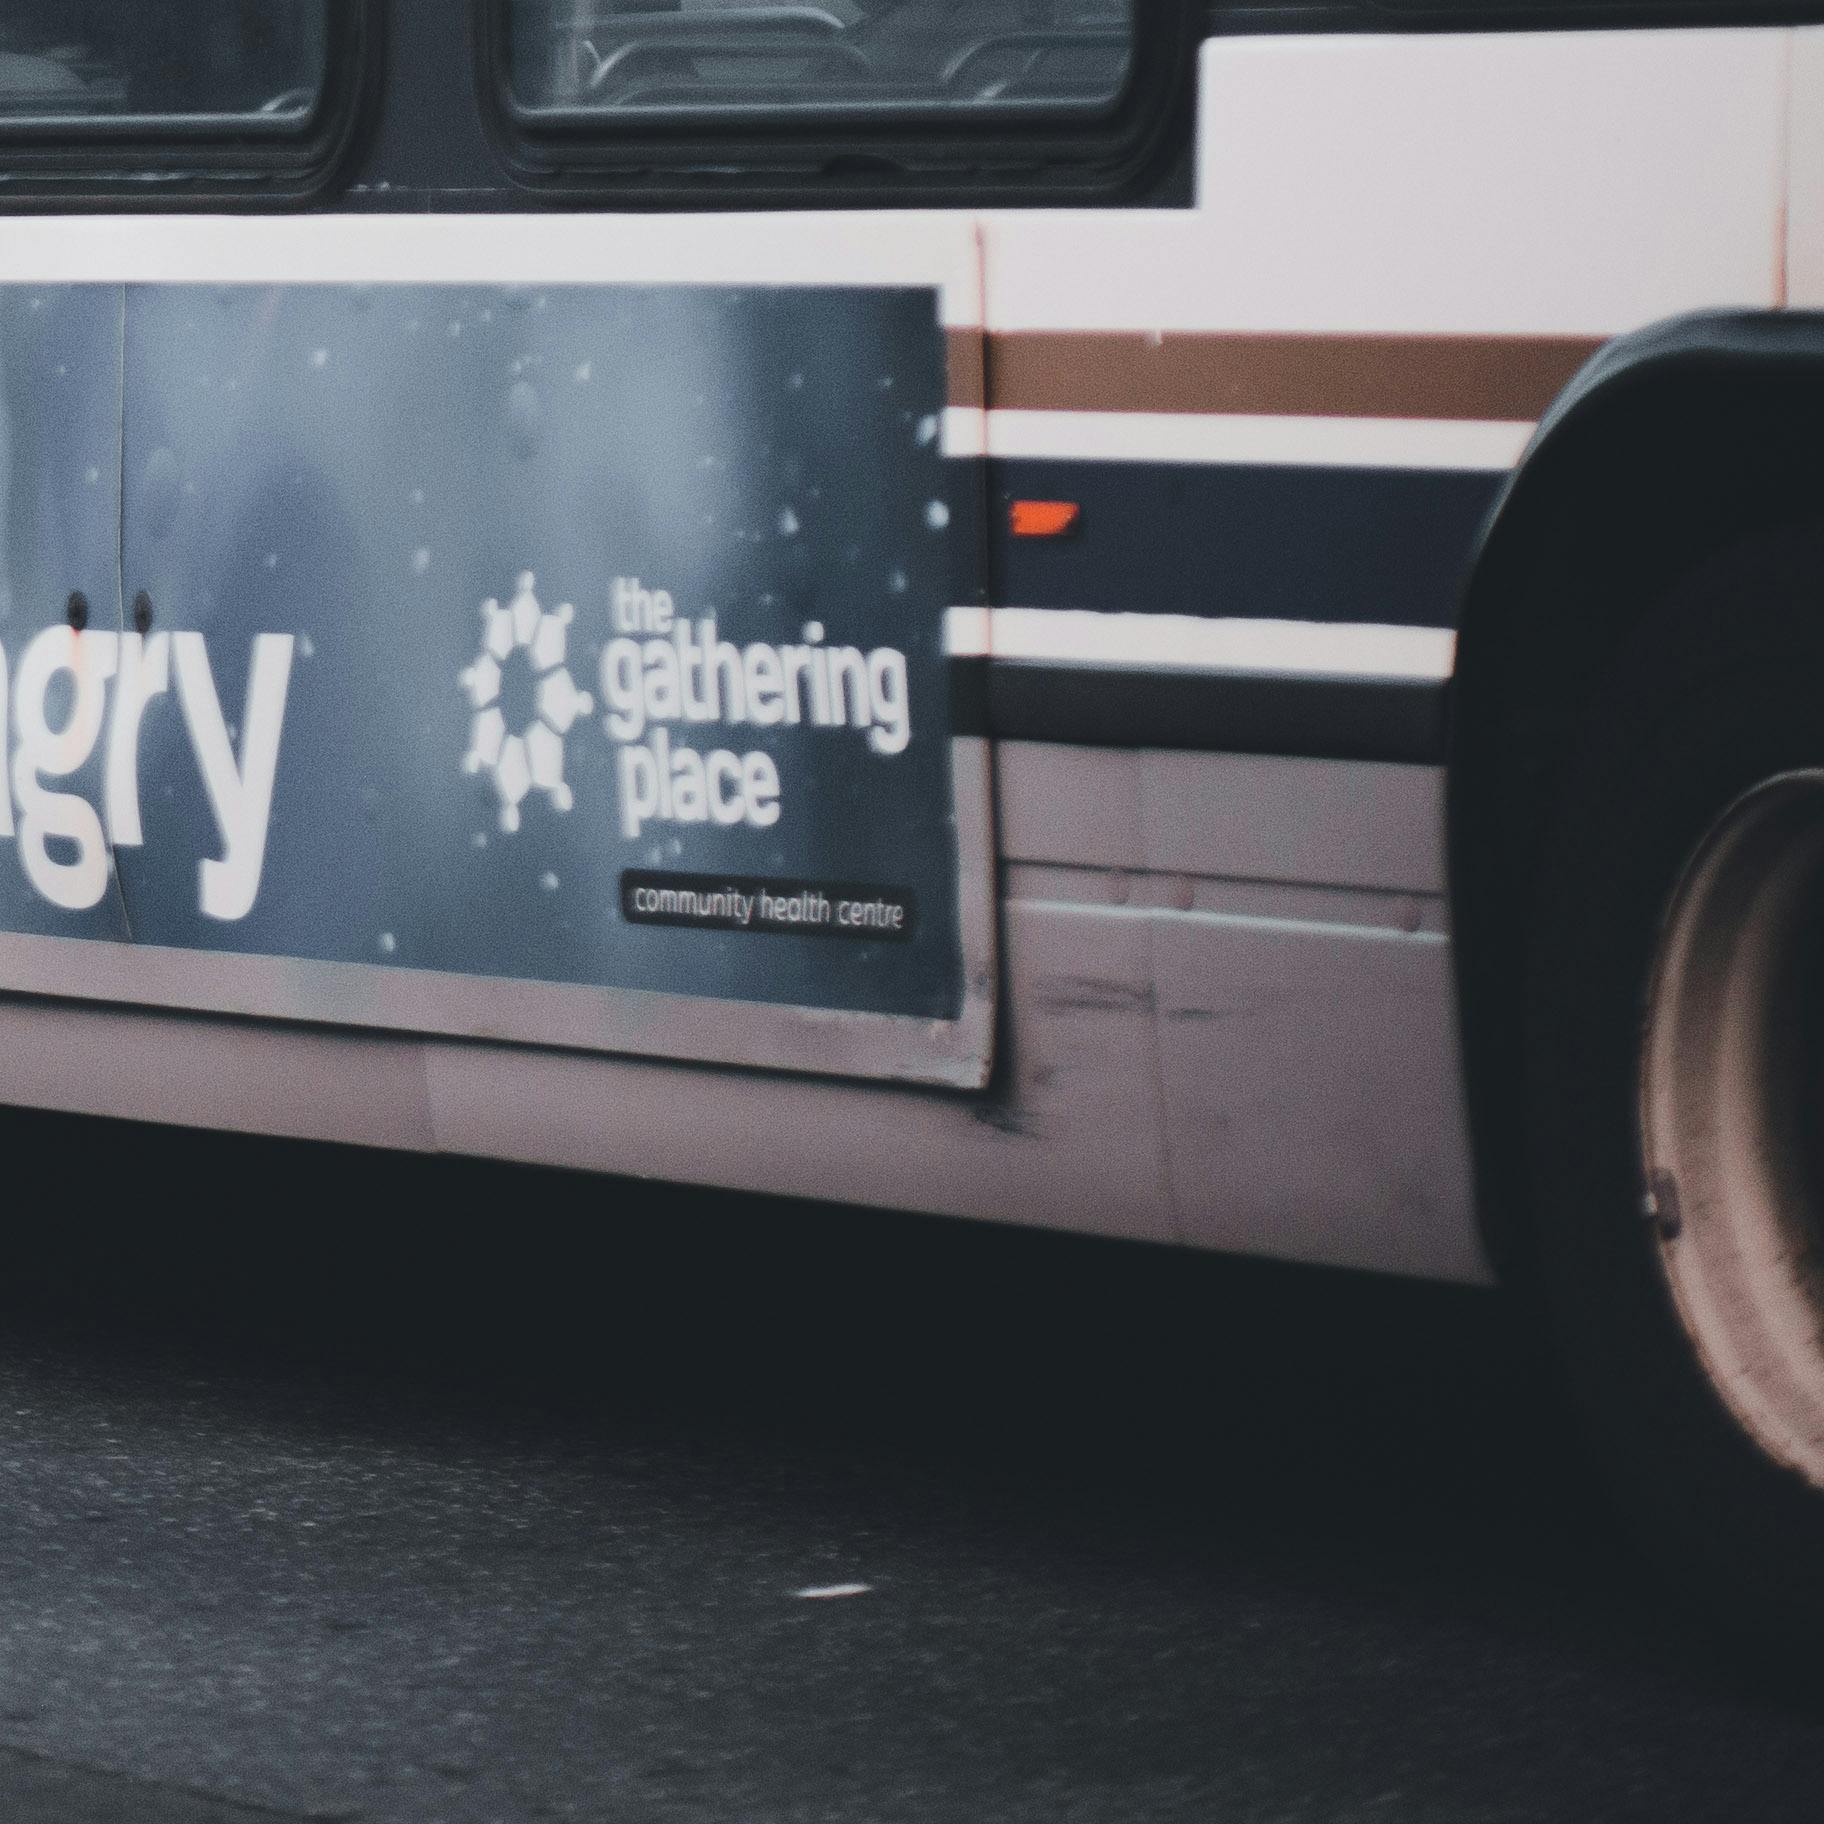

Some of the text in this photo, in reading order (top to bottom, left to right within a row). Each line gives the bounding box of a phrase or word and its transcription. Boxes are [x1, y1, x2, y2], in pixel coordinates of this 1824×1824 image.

[614, 576, 674, 632] the
[602, 616, 910, 754] gathering
[620, 726, 781, 838] place
[634, 886, 904, 929] community health centre
